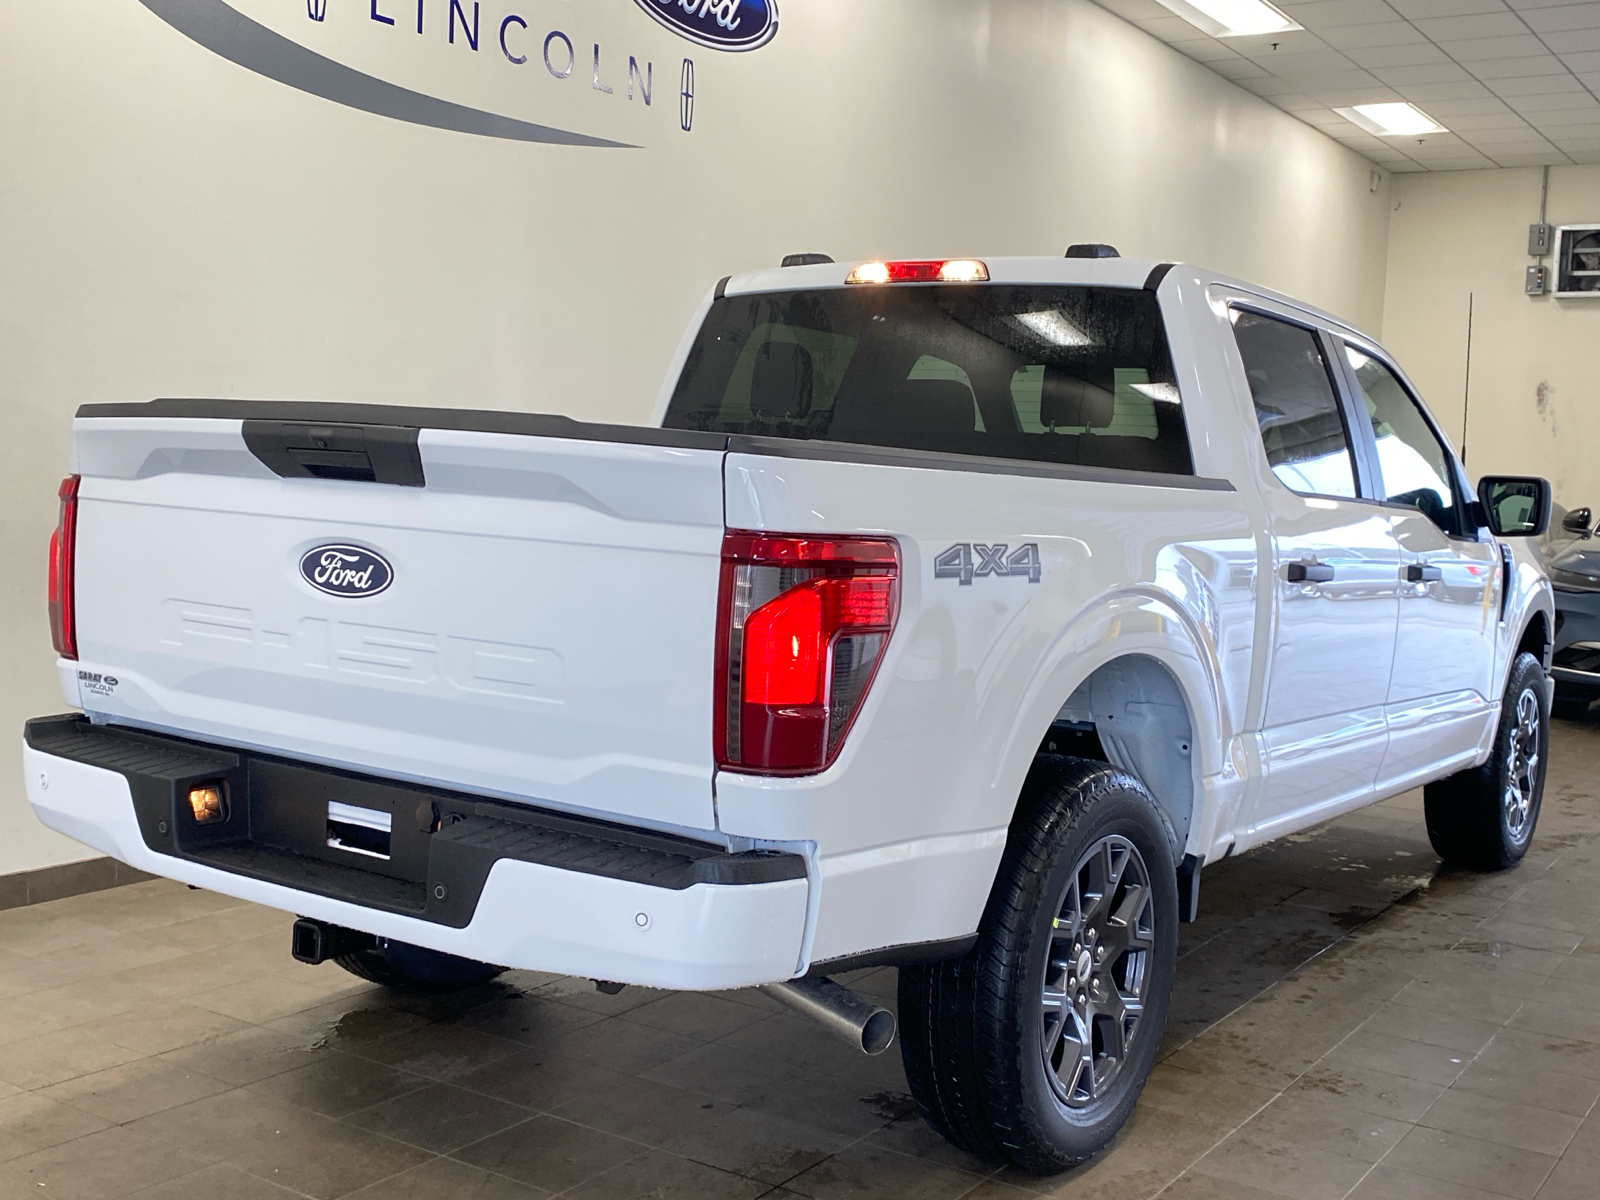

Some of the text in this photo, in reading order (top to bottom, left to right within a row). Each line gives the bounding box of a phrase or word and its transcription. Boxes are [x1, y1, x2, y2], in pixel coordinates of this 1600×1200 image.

[658, 0, 741, 31] ord
[314, 551, 374, 589] Ford
[160, 598, 566, 704] F-150
[84, 681, 114, 693] LINCOLN
